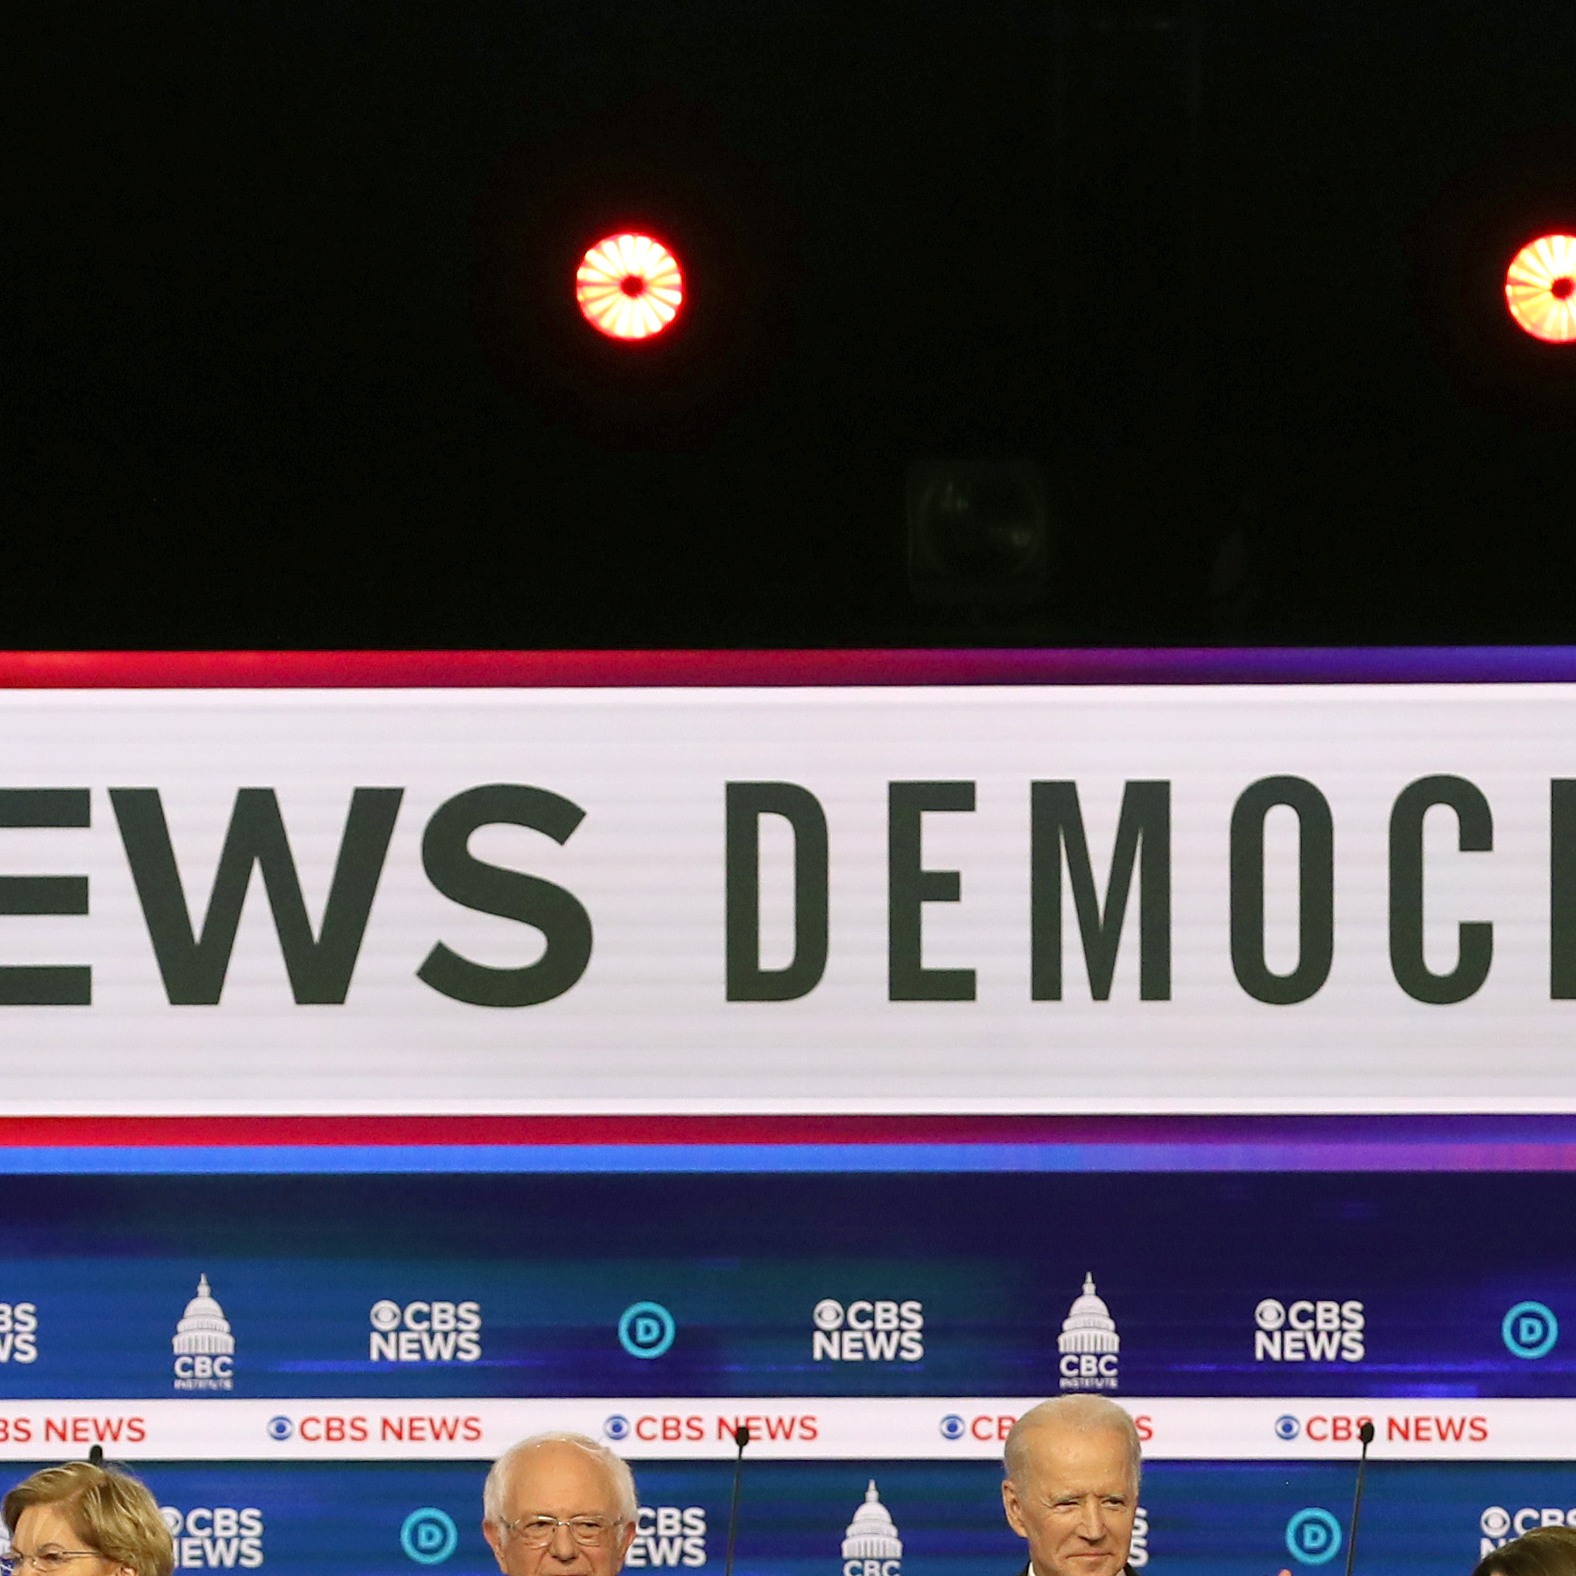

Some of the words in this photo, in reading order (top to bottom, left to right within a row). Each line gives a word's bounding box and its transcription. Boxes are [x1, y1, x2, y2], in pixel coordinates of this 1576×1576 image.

[403, 1301, 481, 1331] CBS
[846, 1301, 922, 1330] CBS
[1289, 1301, 1364, 1331] CBS
[635, 1317, 660, 1343] D
[1519, 1317, 1544, 1344] D
[370, 1332, 481, 1362] NEWS
[814, 1331, 923, 1362] NEWS
[1255, 1331, 1365, 1362] NEWS
[174, 1356, 233, 1379] CBC
[1061, 1354, 1118, 1377] CBC
[45, 1418, 146, 1442] NEWS
[300, 1417, 369, 1442] CBS
[382, 1417, 482, 1442] NEWS
[636, 1416, 705, 1441] CBS
[717, 1416, 818, 1441] NEWS
[971, 1416, 1017, 1441] CB
[1388, 1417, 1488, 1442] NEWS
[185, 1508, 263, 1538] CBS
[635, 1507, 707, 1537] CBS
[418, 1523, 443, 1549] D
[1303, 1523, 1328, 1549] D
[173, 1538, 264, 1568] EWS
[625, 1537, 707, 1568] EWS
